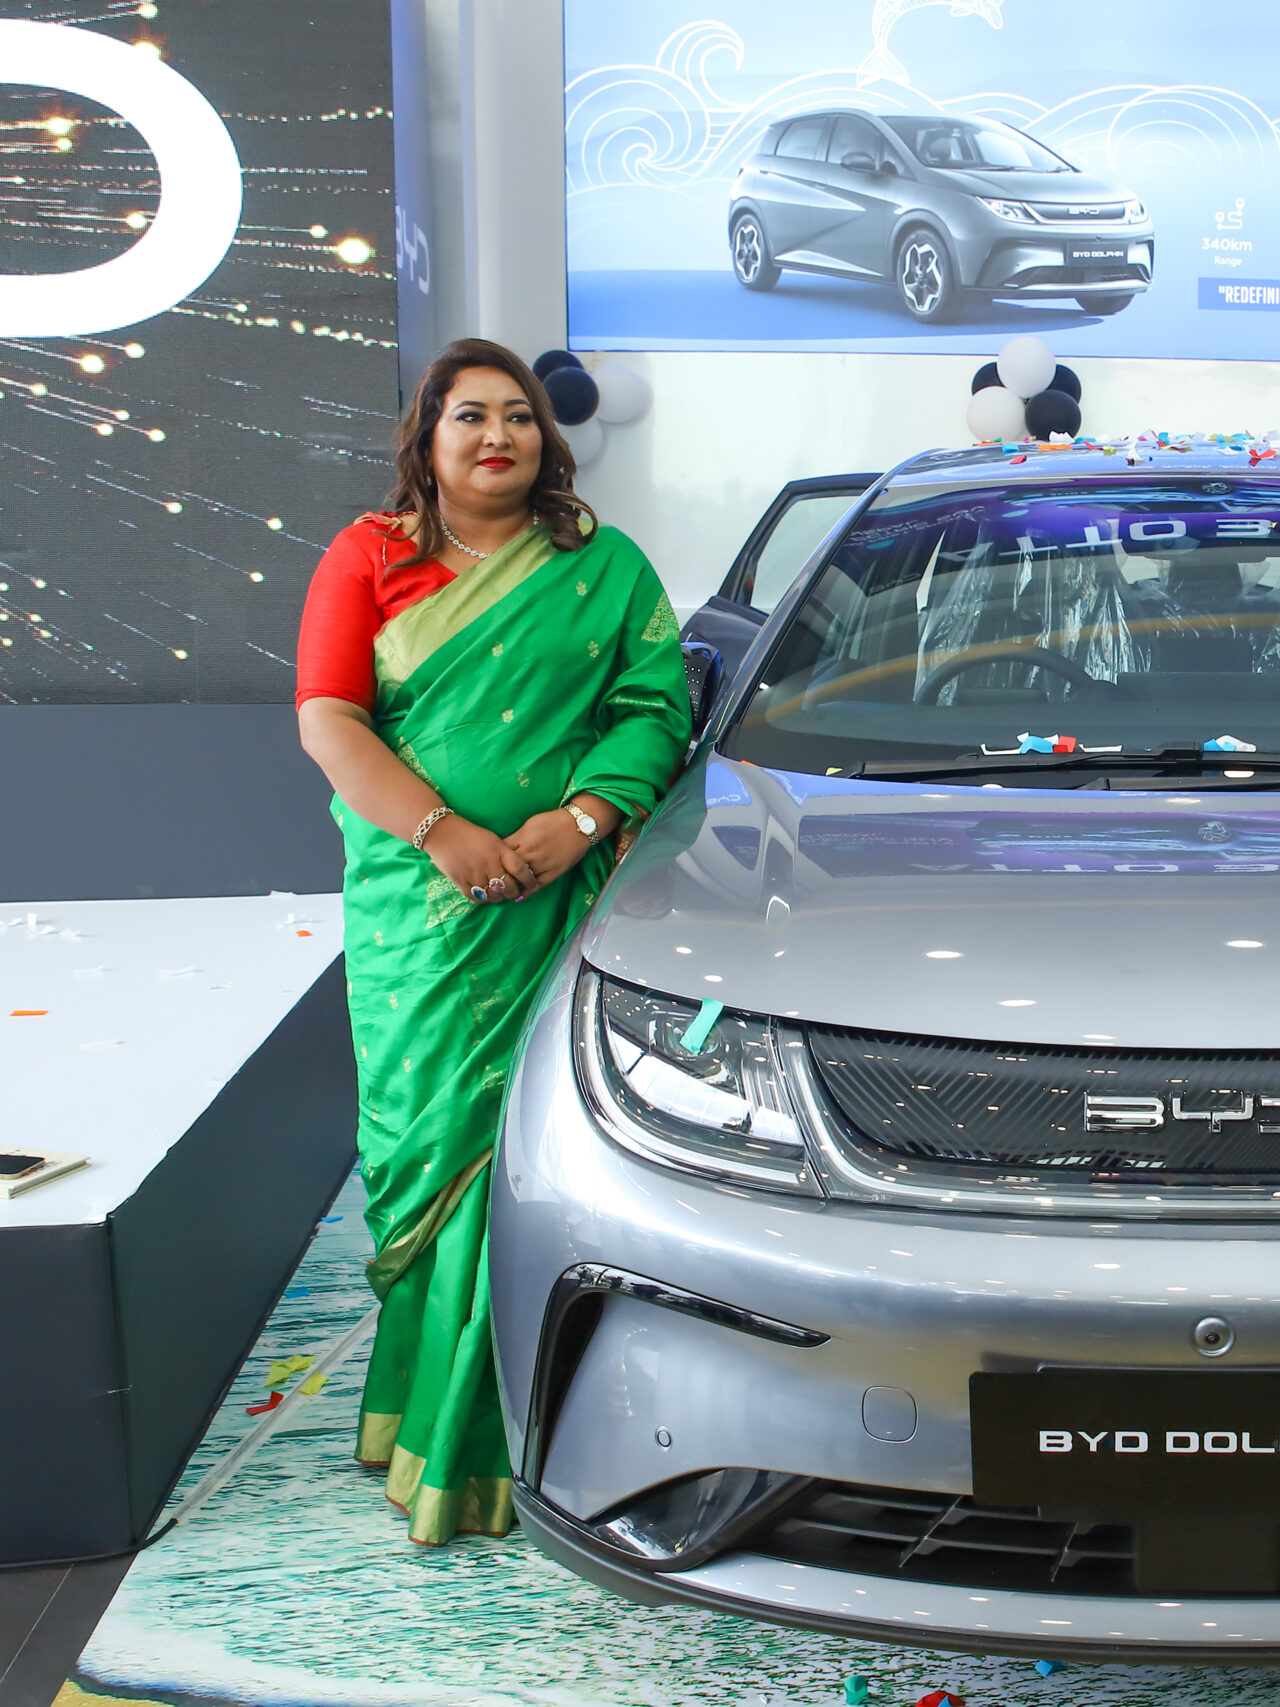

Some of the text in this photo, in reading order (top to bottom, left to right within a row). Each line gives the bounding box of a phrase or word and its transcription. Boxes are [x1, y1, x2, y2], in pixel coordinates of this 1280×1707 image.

[1201, 238, 1253, 252] 340km
[1214, 256, 1242, 268] Range
[1038, 1429, 1149, 1453] BYD
